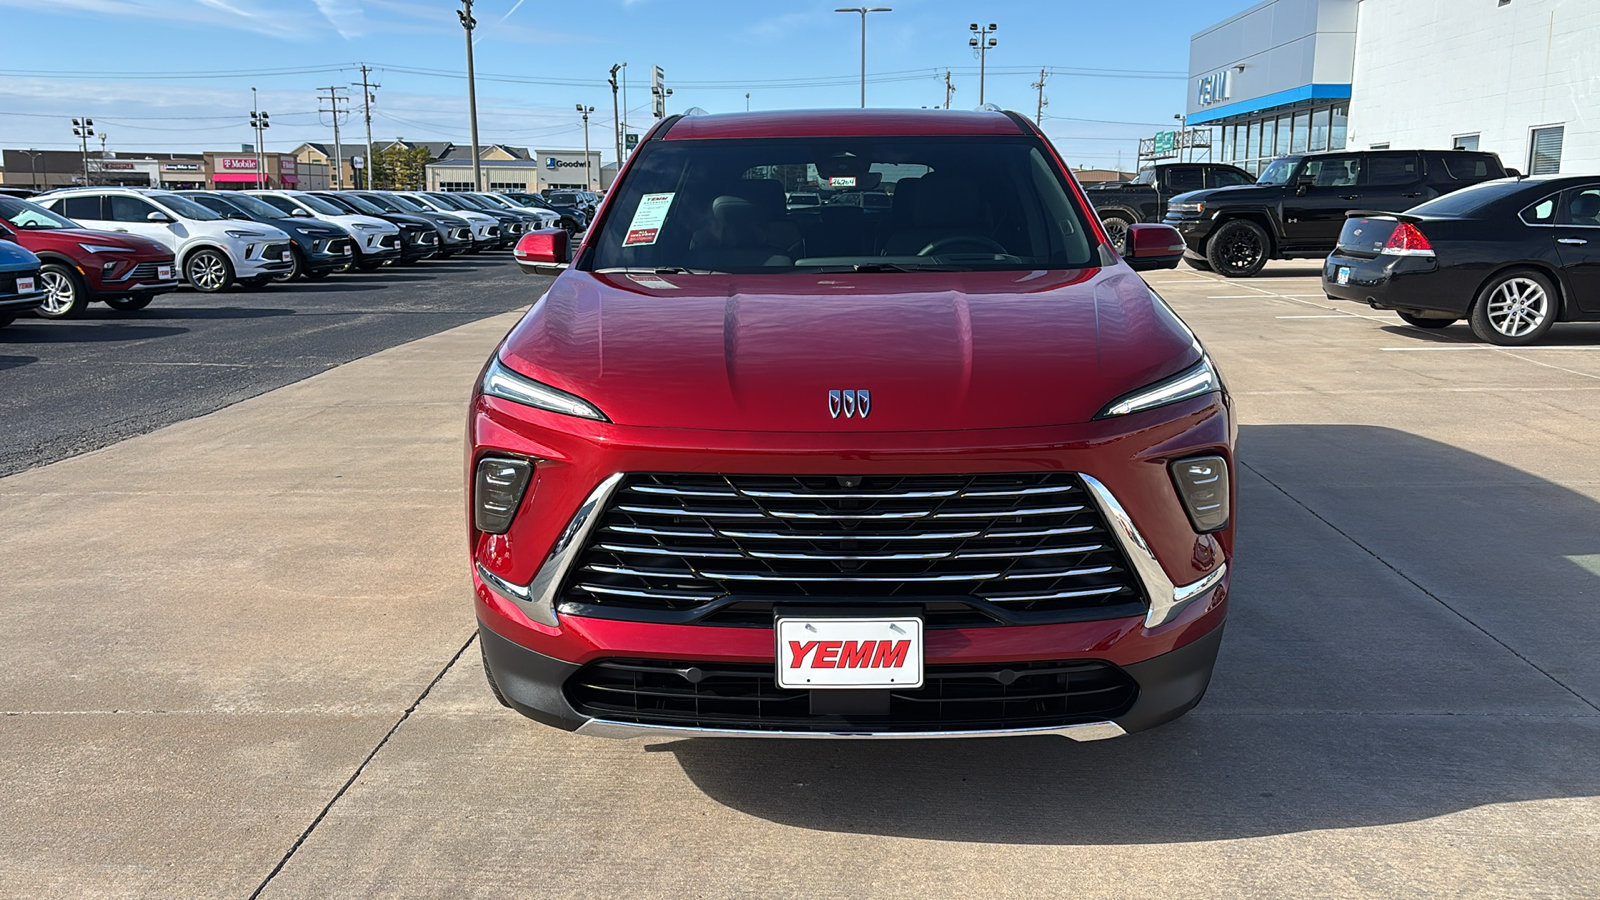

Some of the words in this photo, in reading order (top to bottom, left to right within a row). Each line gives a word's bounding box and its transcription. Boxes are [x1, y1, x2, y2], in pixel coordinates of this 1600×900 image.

[231, 159, 256, 168] Mobile
[556, 160, 591, 168] Goodwil
[788, 640, 911, 669] YEMM
